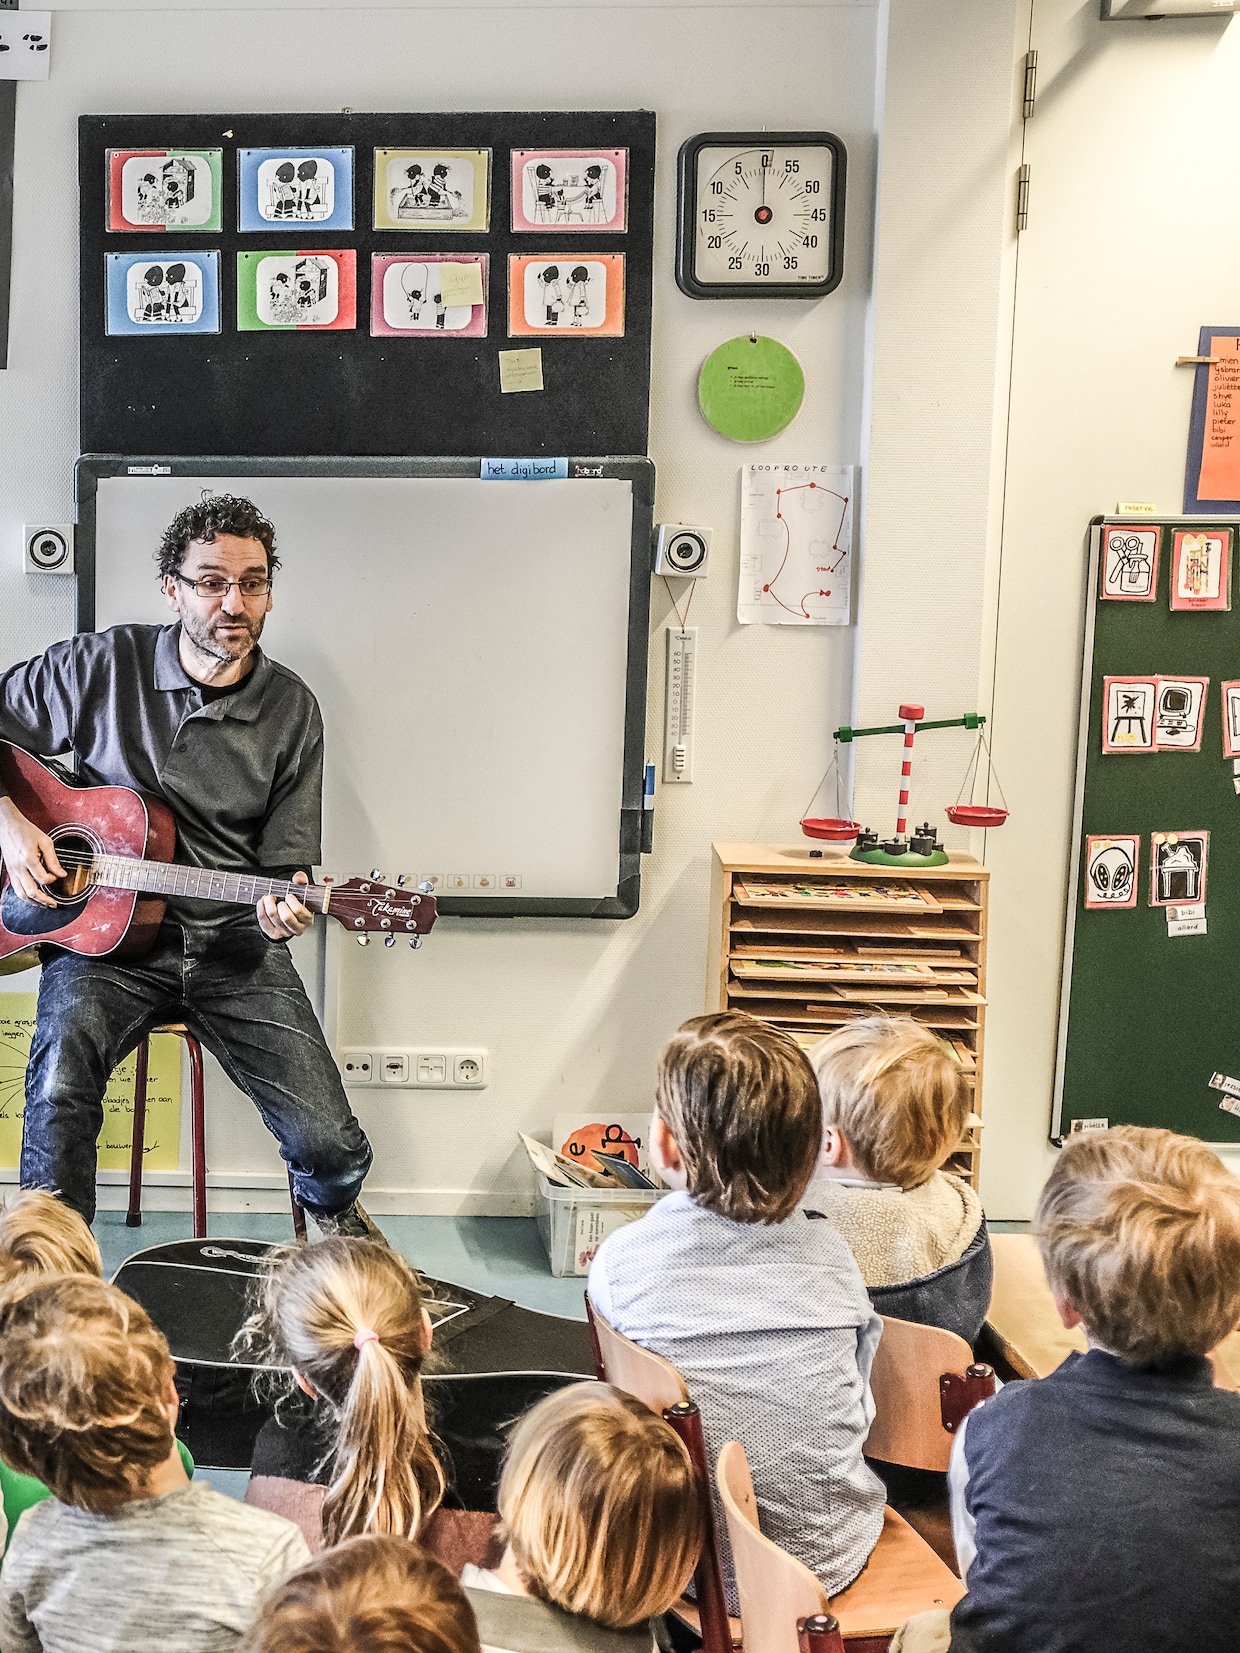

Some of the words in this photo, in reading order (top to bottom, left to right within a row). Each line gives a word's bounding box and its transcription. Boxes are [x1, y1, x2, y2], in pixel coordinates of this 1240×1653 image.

[762, 155, 769, 168] 0
[785, 160, 799, 173] 55
[735, 162, 742, 175] 5
[710, 182, 723, 195] 10
[805, 181, 820, 193] 50
[702, 209, 716, 222] 15
[811, 209, 826, 221] 45
[707, 236, 722, 248] 20
[802, 235, 818, 248] 40
[728, 257, 742, 270] 25
[754, 264, 770, 276] 30
[783, 257, 798, 270] 35
[1217, 357, 1239, 365] mien
[487, 462, 507, 475] het
[367, 898, 412, 917] Takamine
[1177, 923, 1199, 931] allard
